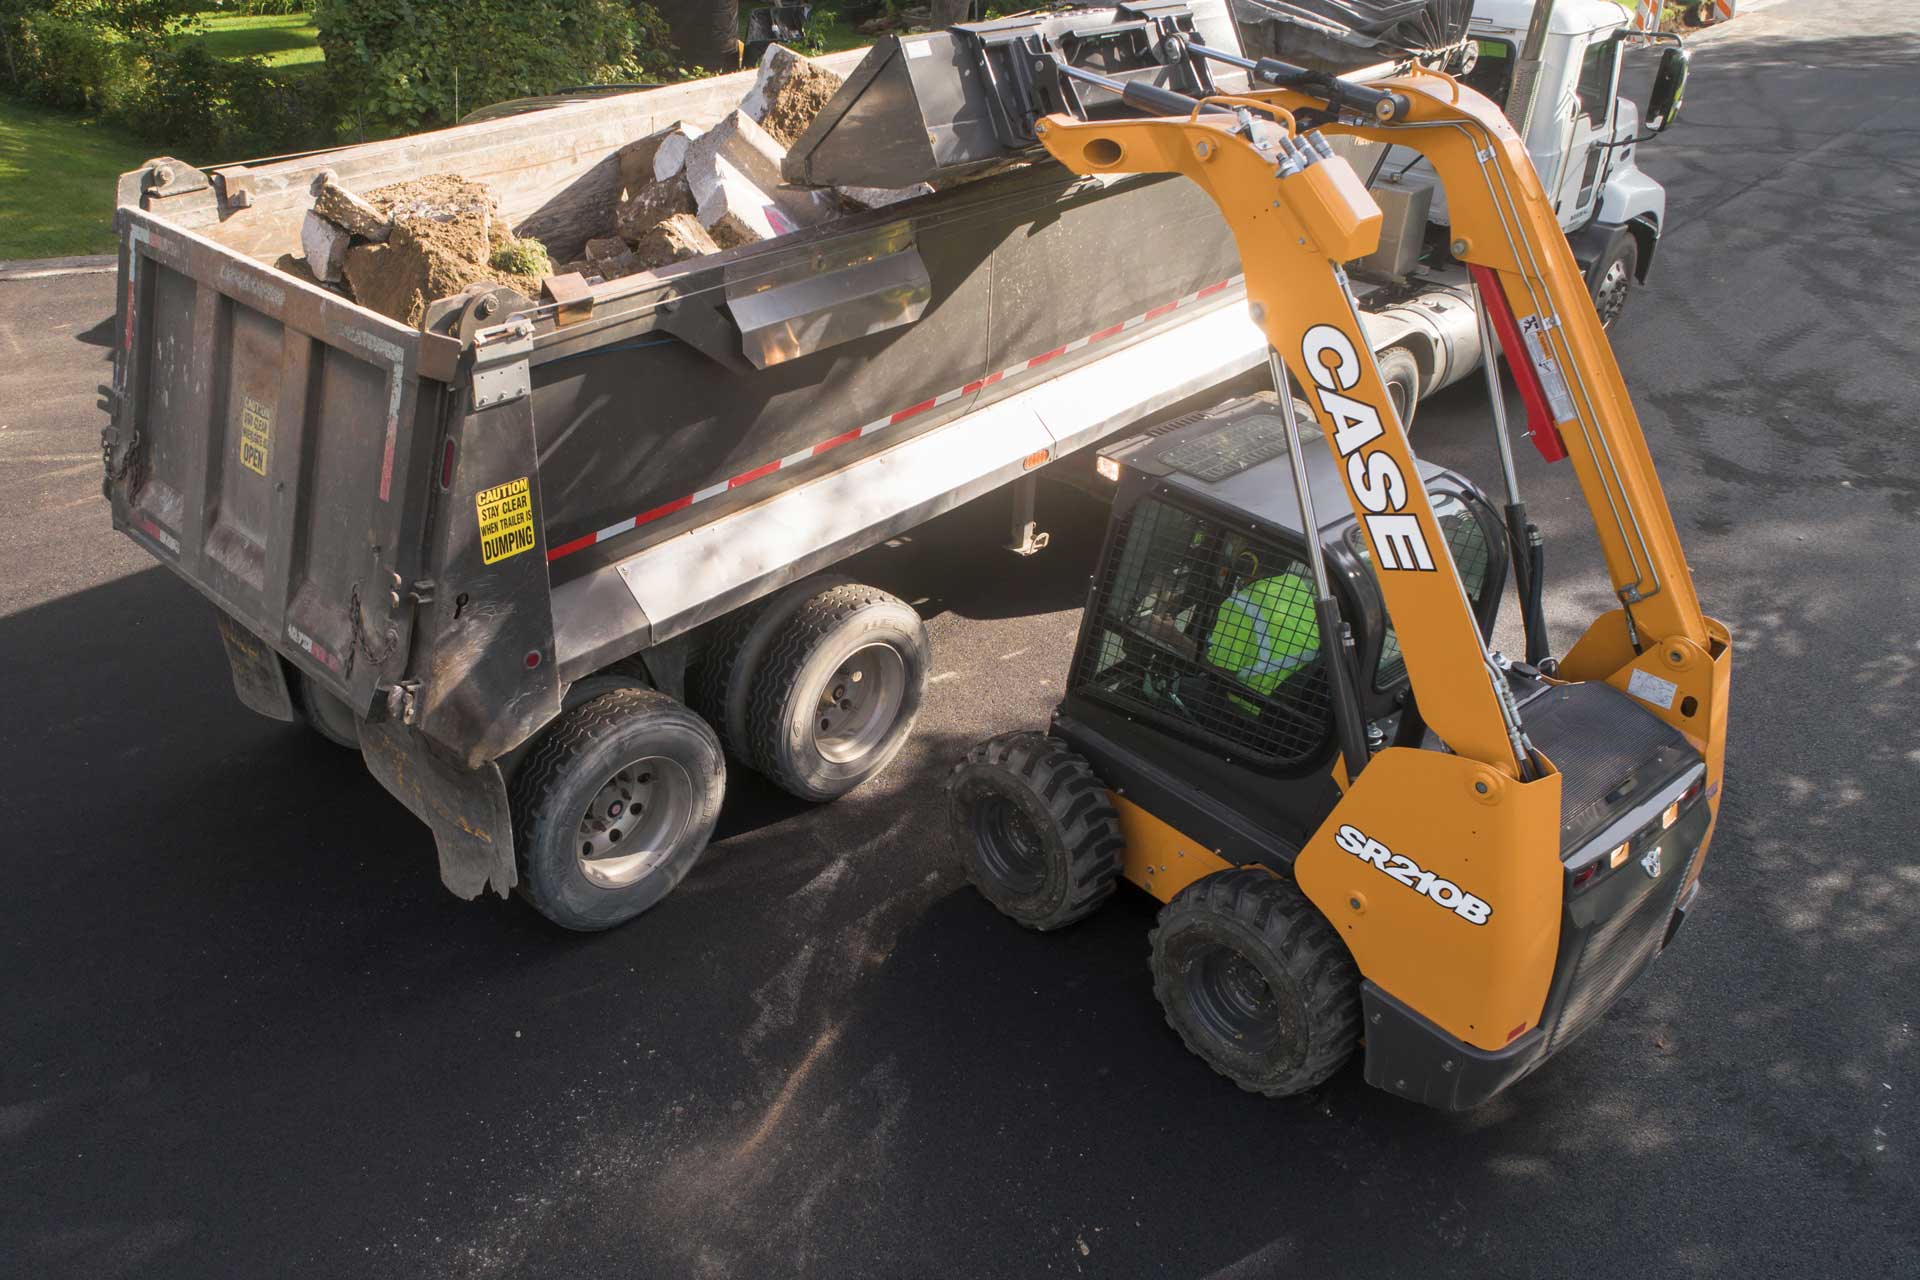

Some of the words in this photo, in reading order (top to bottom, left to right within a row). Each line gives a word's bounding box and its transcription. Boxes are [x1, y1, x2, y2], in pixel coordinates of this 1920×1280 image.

[244, 443, 264, 472] OPEN
[1301, 323, 1437, 572] CASE
[477, 479, 528, 506] CAUTION
[481, 505, 499, 521] STAY
[502, 495, 527, 514] CLEAR
[481, 521, 499, 537] WHEN
[500, 512, 525, 530] TRAILER
[526, 510, 532, 522] IS
[483, 526, 533, 561] DUMPING
[1334, 823, 1493, 926] SR210B
